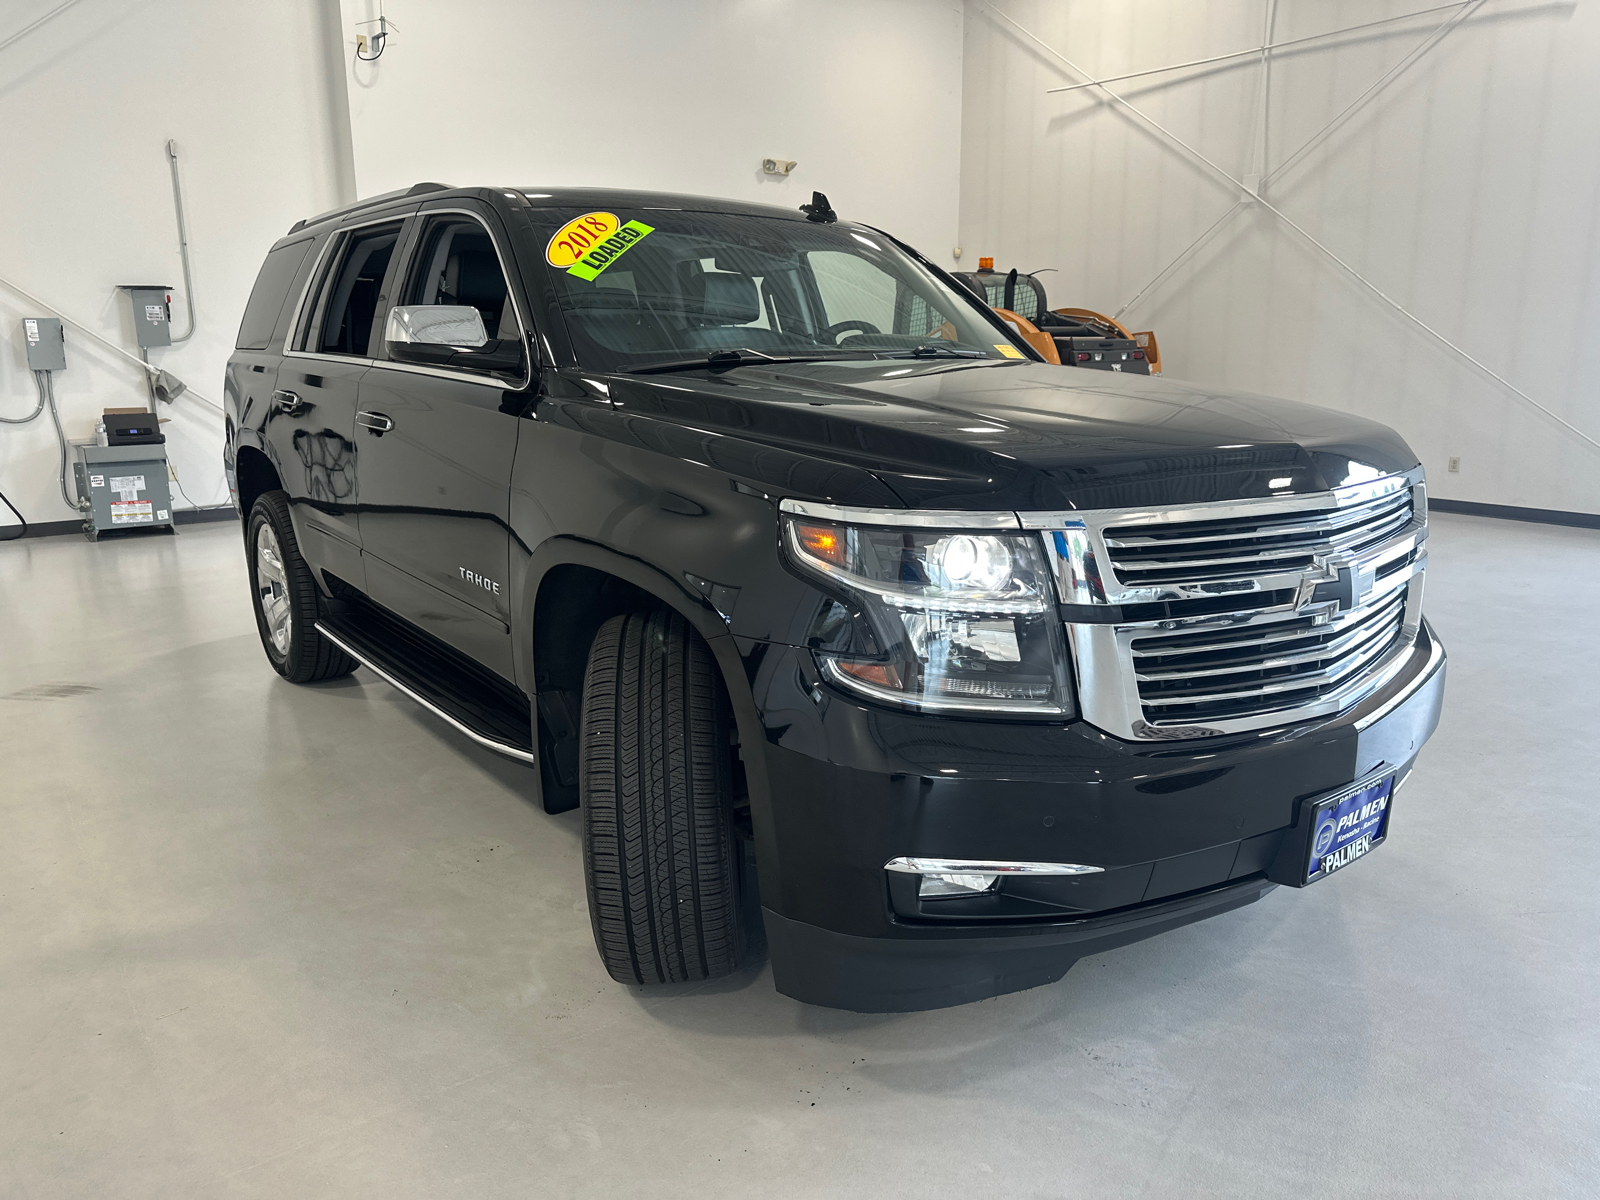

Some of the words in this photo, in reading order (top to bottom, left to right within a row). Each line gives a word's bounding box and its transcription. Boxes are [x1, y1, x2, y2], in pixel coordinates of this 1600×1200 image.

[557, 216, 609, 260] 2018
[581, 227, 643, 271] LOADED
[459, 566, 500, 596] TAHOE
[1339, 779, 1382, 805] palmen.com
[1336, 795, 1389, 834] PALMEN
[1325, 834, 1370, 873] PALMEN
[1337, 827, 1360, 843] Kenosha
